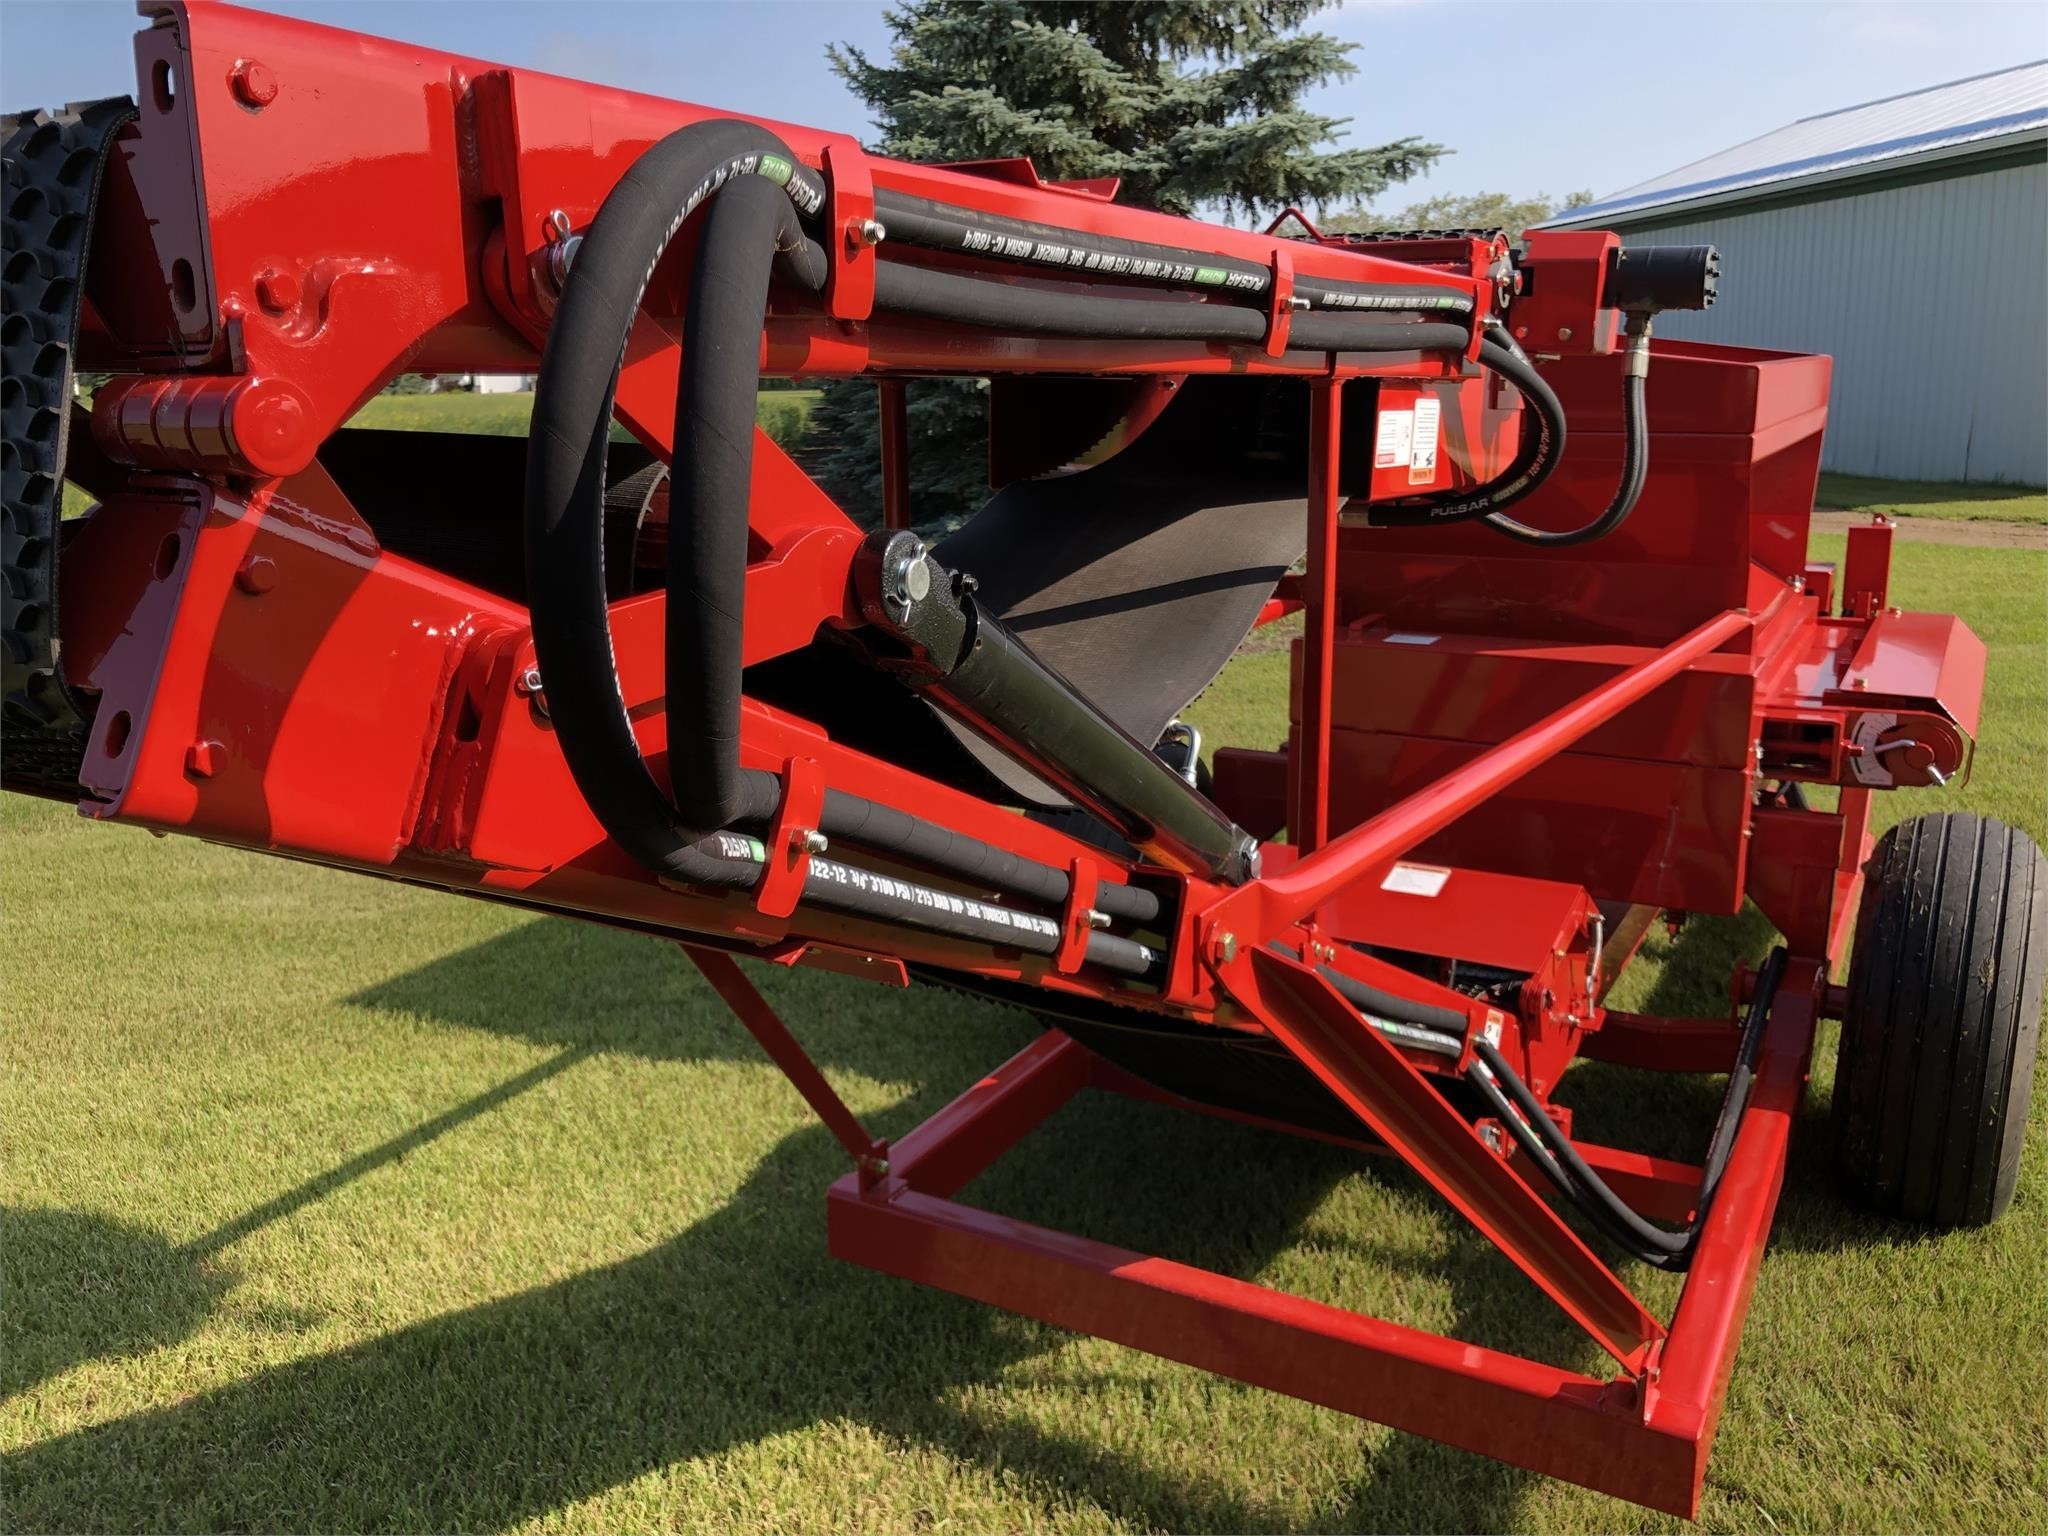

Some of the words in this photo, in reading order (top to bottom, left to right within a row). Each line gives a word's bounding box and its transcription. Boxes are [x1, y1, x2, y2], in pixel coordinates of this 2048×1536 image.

[786, 170, 822, 214] PULSAR
[1004, 238, 1033, 258] MSHA
[1067, 249, 1086, 266] SAE
[1226, 272, 1265, 291] PULSAR
[1430, 498, 1489, 517] PULSAR
[719, 836, 751, 858] PULSAR
[808, 858, 848, 884] 122-12
[870, 874, 895, 897] 3100
[894, 881, 910, 901] PSI
[915, 888, 933, 906] 215
